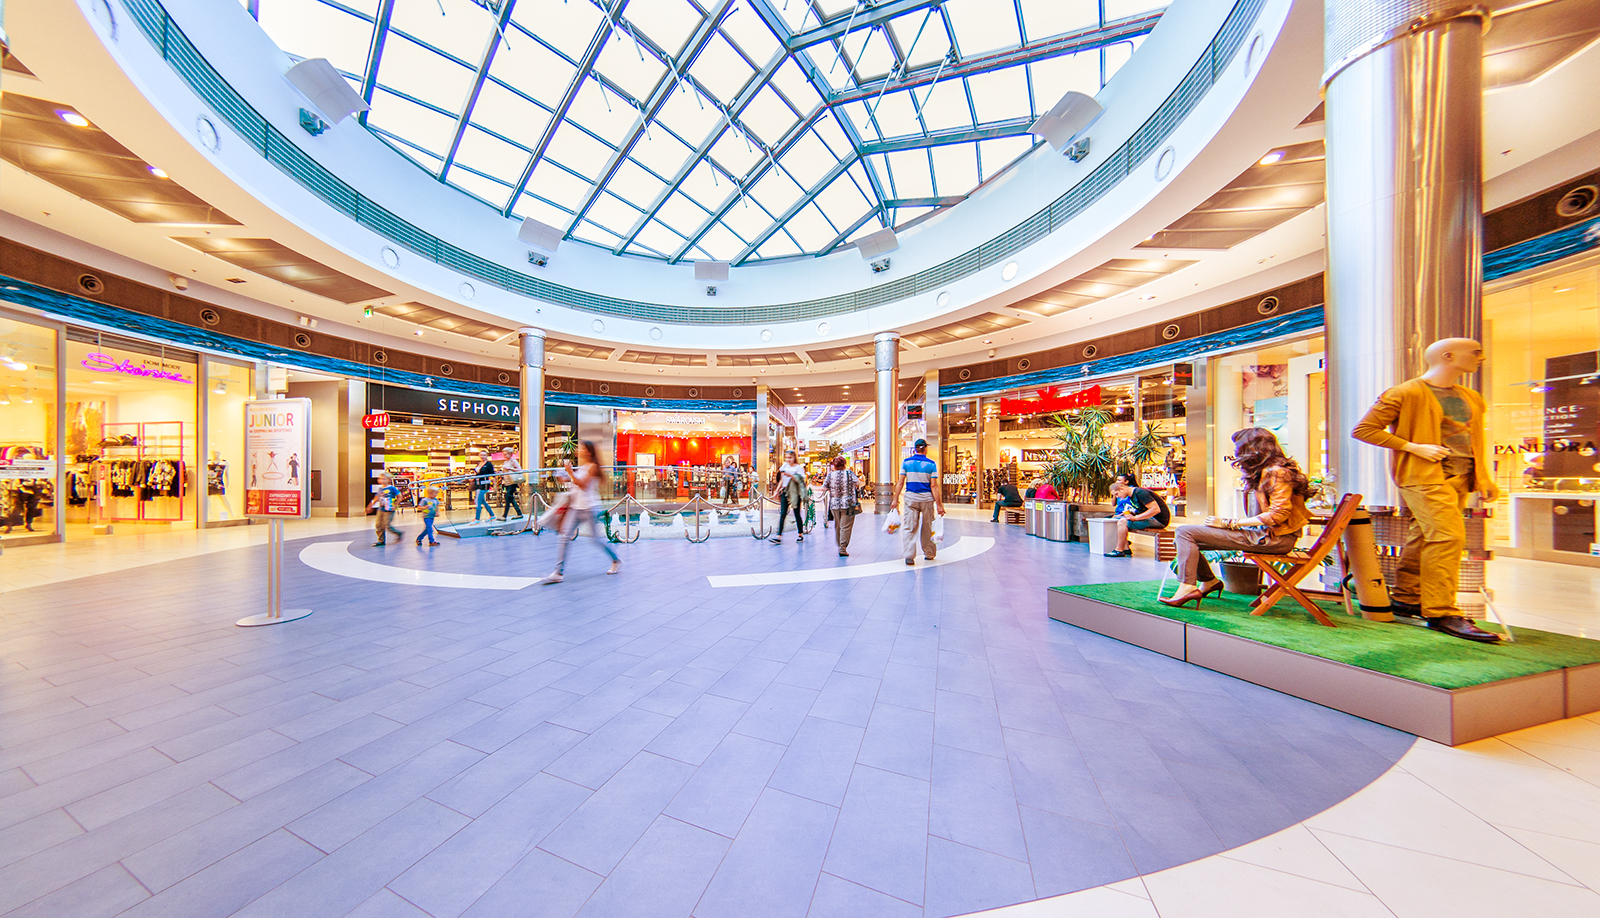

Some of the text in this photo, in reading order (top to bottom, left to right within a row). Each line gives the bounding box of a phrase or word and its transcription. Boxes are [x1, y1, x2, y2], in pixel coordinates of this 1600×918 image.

[438, 398, 520, 417] SEPHORA
[249, 412, 294, 428] JUNIOR
[665, 416, 706, 424] SWAROVSKI
[1493, 440, 1597, 455] PANDORA
